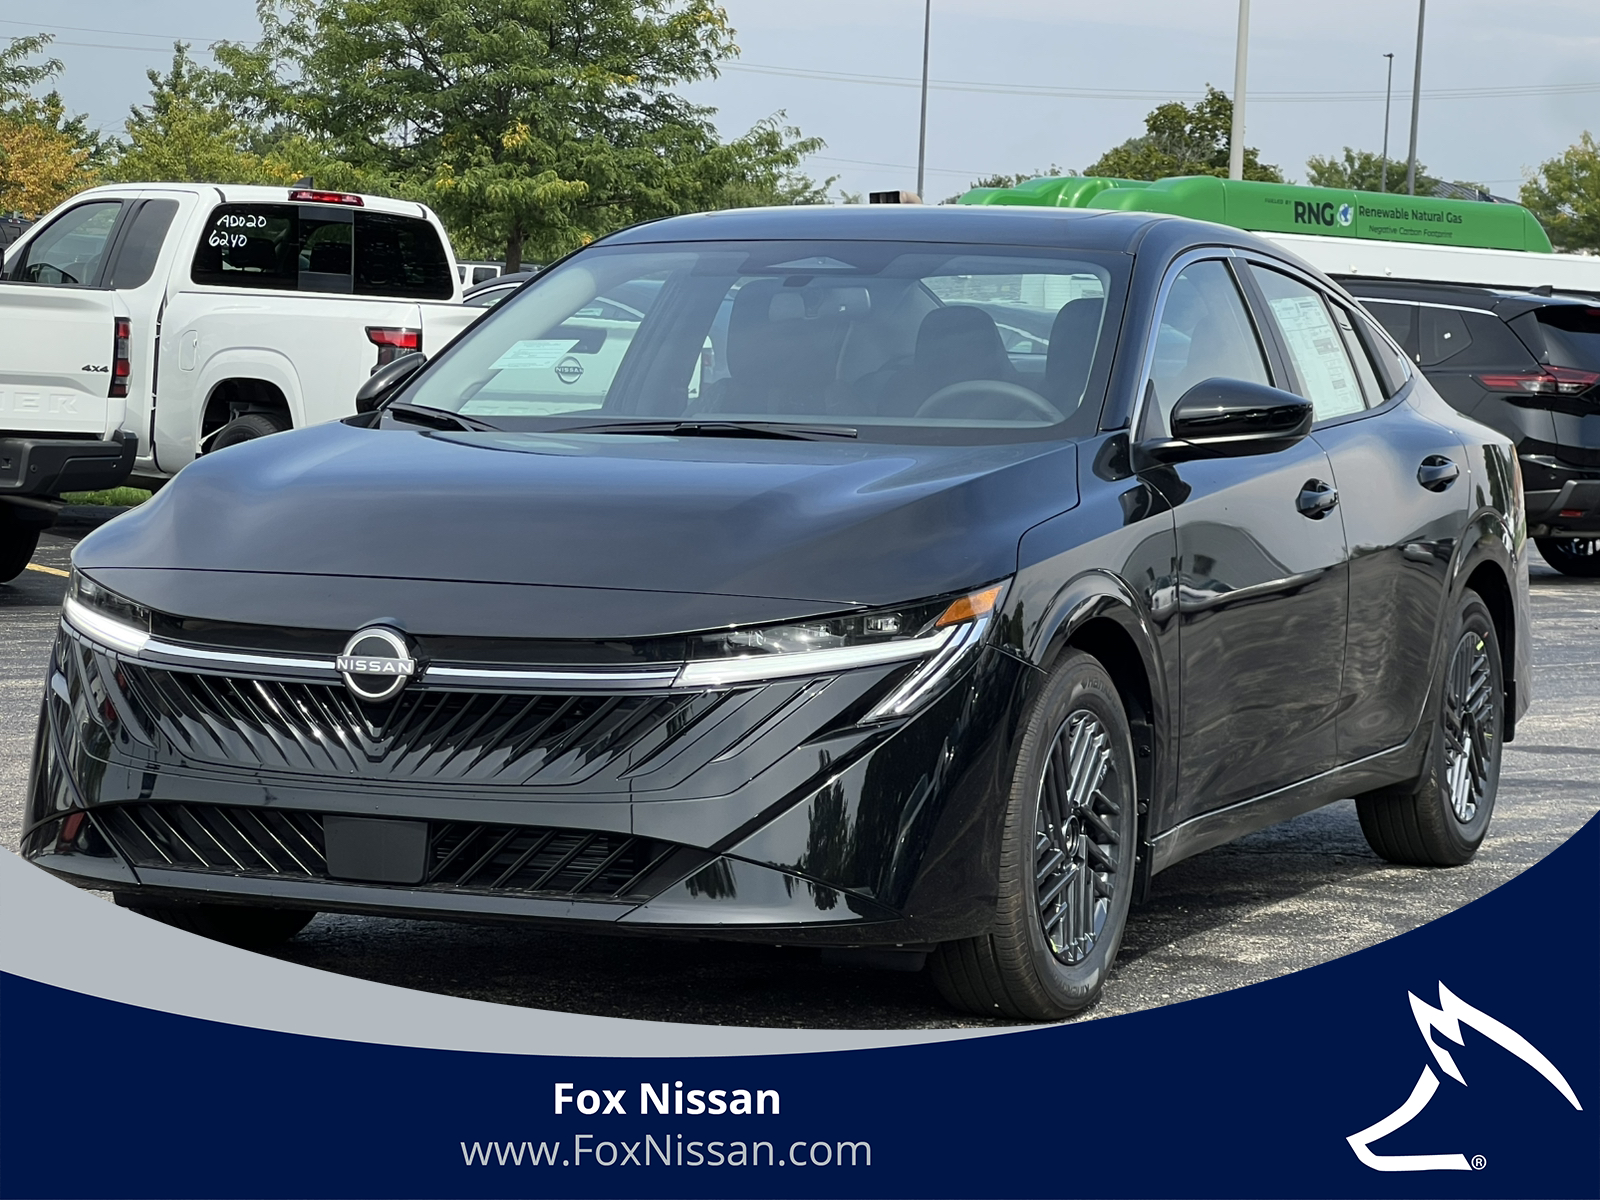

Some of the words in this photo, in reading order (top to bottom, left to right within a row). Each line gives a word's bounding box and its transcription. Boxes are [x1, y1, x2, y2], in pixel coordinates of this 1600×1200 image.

[1294, 201, 1335, 227] RNG
[1358, 205, 1409, 220] Renewable
[1411, 209, 1444, 223] Natural
[1446, 212, 1463, 224] Gas
[208, 229, 248, 248] 6240
[1369, 225, 1398, 235] Negative
[1399, 227, 1422, 236] Carbon
[1423, 229, 1453, 238] Footprint
[555, 366, 584, 374] NISSAN
[337, 658, 412, 673] NISSAN
